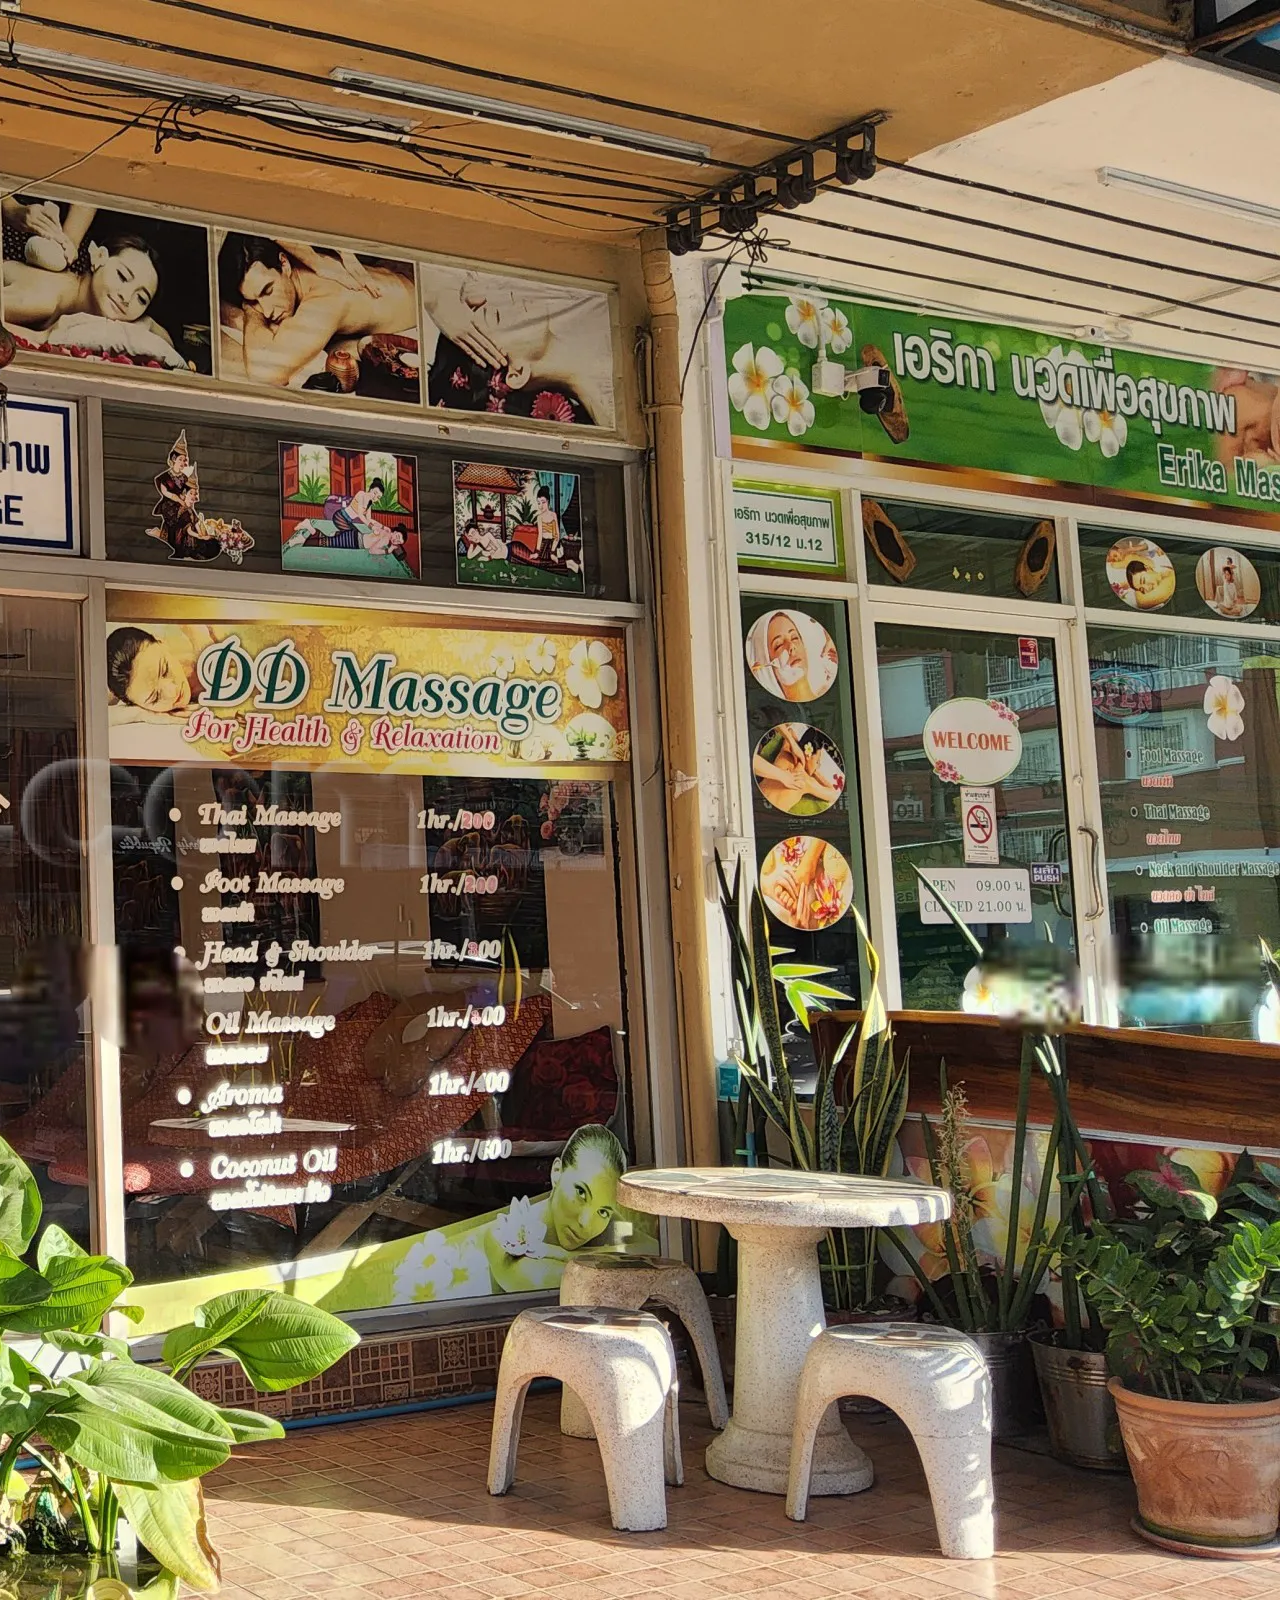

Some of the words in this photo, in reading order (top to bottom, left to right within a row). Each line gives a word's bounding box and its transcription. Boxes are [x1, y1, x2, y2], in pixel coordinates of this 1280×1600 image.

[892, 329, 996, 393] เอริกา
[1009, 346, 1237, 435] นวดเพื่อสุขภาพ
[1157, 443, 1227, 492] Erika
[745, 531, 791, 548] 315/12
[797, 538, 823, 551] ม.12
[201, 638, 308, 706] DD
[325, 653, 560, 736] Massage
[187, 713, 235, 743] For
[237, 714, 329, 751] Health
[343, 718, 363, 752] &
[371, 717, 502, 753] Relaxation
[932, 731, 1015, 751] WELCOME
[1138, 747, 1162, 763] Foot
[1163, 748, 1204, 765] Massage
[197, 802, 248, 826] Thai
[253, 804, 343, 833] Massage
[1144, 804, 1168, 819] Thai
[1169, 804, 1210, 821] Massage
[1033, 873, 1060, 883] PUSH
[1148, 861, 1174, 877] Neck
[1175, 863, 1196, 876] and
[1197, 861, 1239, 877] Shoulder
[1240, 861, 1280, 878] Massage
[199, 869, 251, 893] Foot
[255, 872, 345, 900] Massage
[976, 880, 1011, 892] 09.00
[924, 900, 973, 913] CLSED
[977, 901, 1012, 912] 21.00
[1153, 919, 1169, 933] Oil
[1170, 918, 1213, 934] Massage
[195, 940, 259, 970] Head
[288, 939, 379, 962] Shoulder
[206, 1011, 241, 1035] Oil
[245, 1010, 336, 1039] Massage
[200, 1082, 283, 1114] Aroma
[210, 1154, 298, 1180] Coconut
[303, 1146, 338, 1173] Oil
